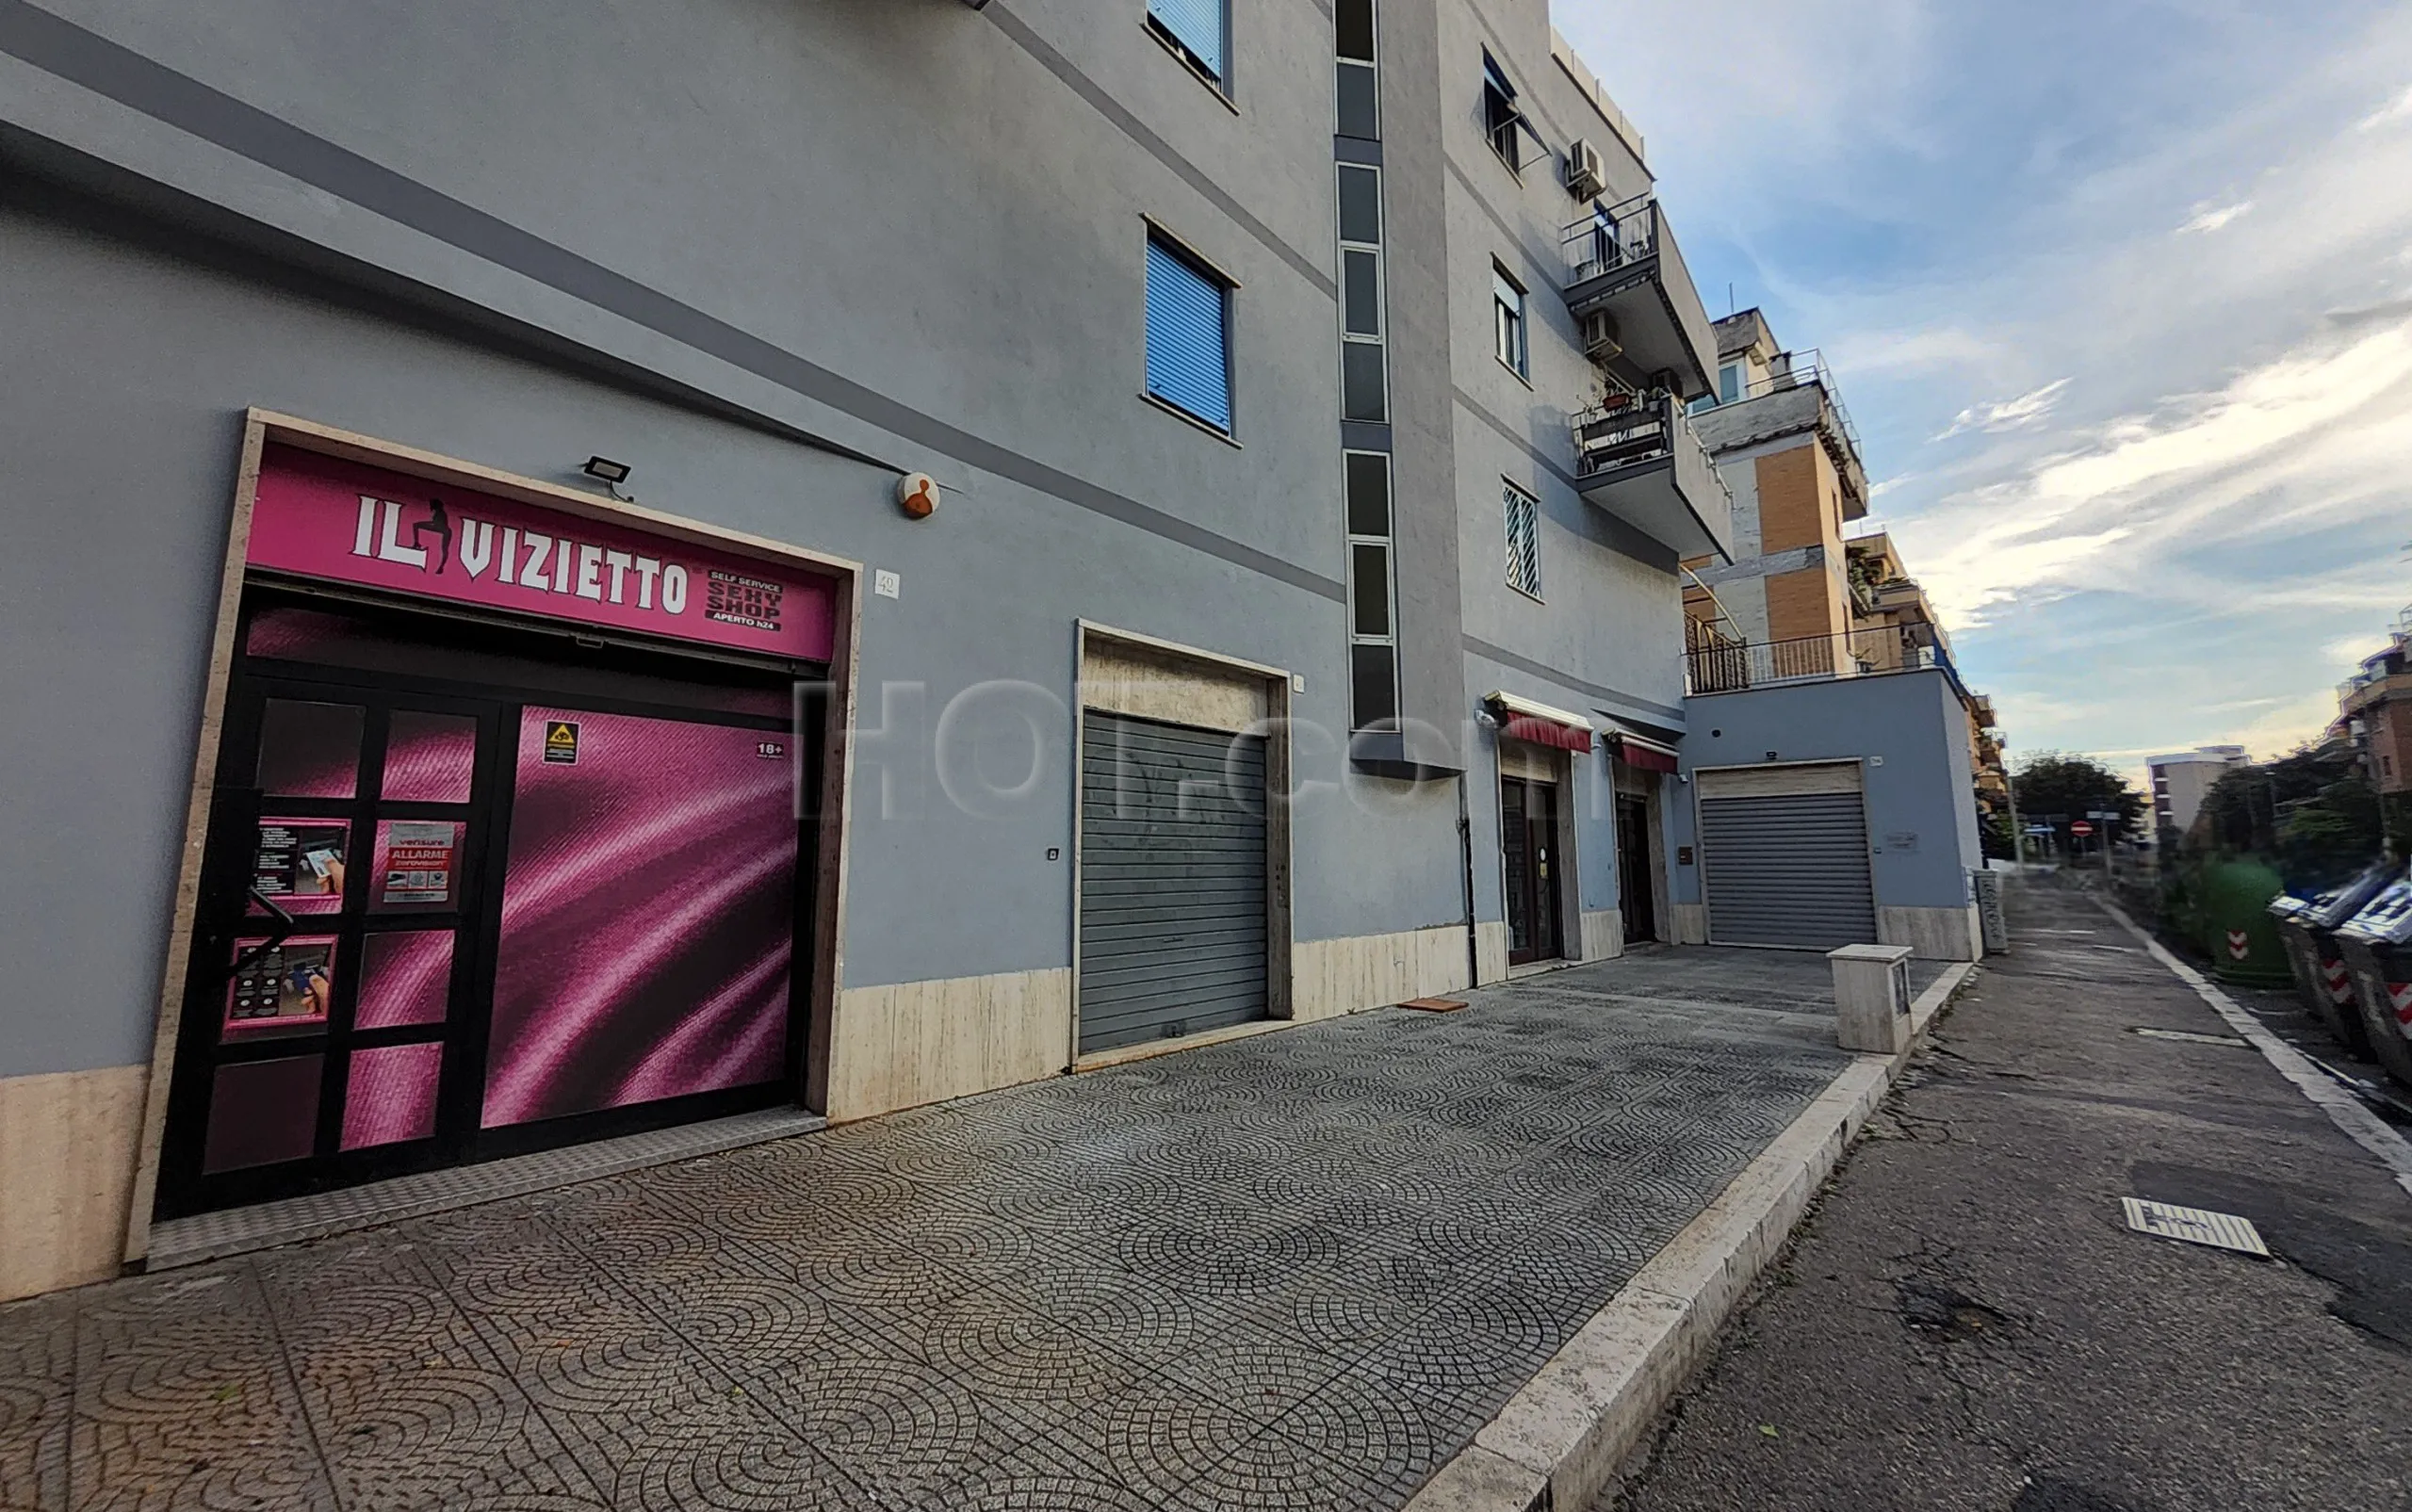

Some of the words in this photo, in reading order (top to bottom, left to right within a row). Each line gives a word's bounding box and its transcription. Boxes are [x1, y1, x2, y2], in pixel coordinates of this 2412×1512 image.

[350, 495, 428, 573] IL
[459, 518, 689, 615] VIZIETTO
[711, 571, 736, 582] SELF
[739, 577, 780, 592] SERVICE
[878, 576, 894, 593] 42
[707, 594, 780, 620] SHOP
[713, 612, 755, 626] APERTO
[757, 620, 774, 629] h24
[758, 742, 782, 754] 18+
[392, 850, 449, 859] ALLARME
